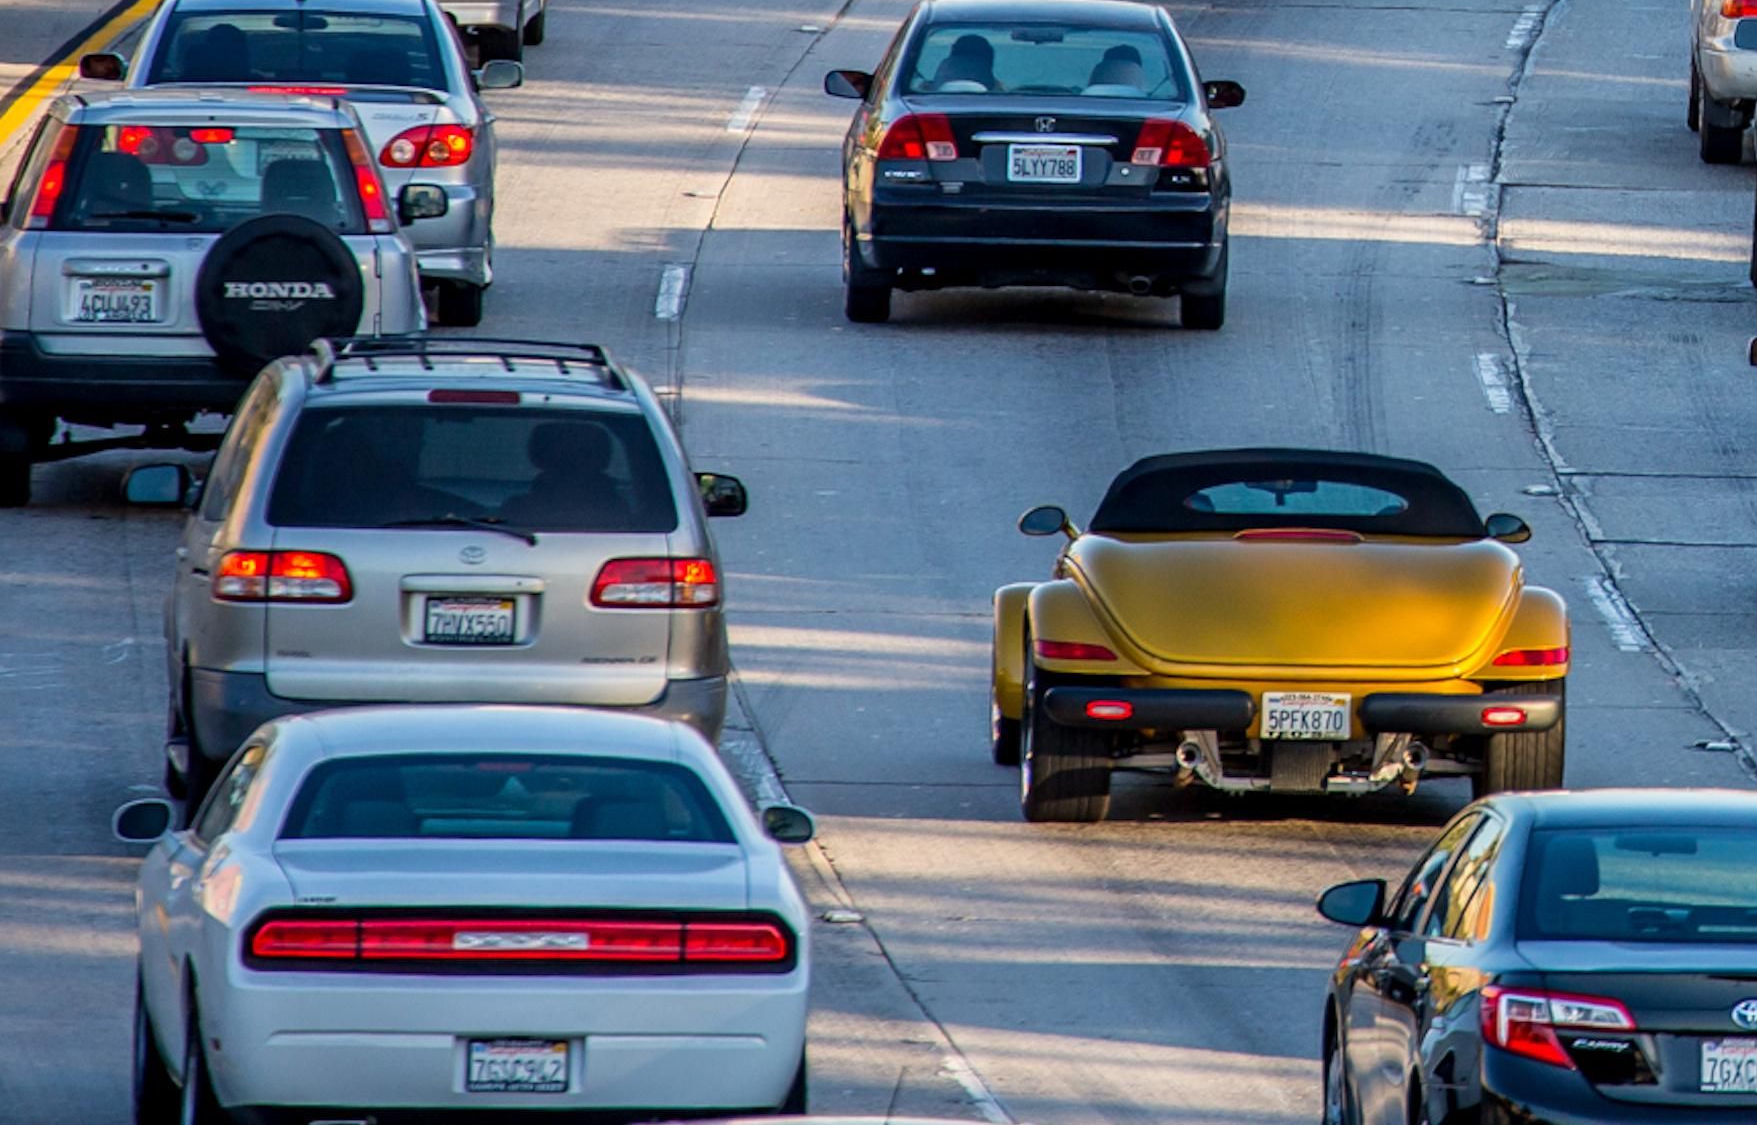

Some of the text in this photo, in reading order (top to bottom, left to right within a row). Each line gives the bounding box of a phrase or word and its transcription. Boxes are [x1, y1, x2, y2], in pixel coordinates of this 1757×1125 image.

[1013, 159, 1075, 178] 5LYY788
[224, 282, 336, 299] HONDA
[1267, 710, 1344, 732] 5PFK870
